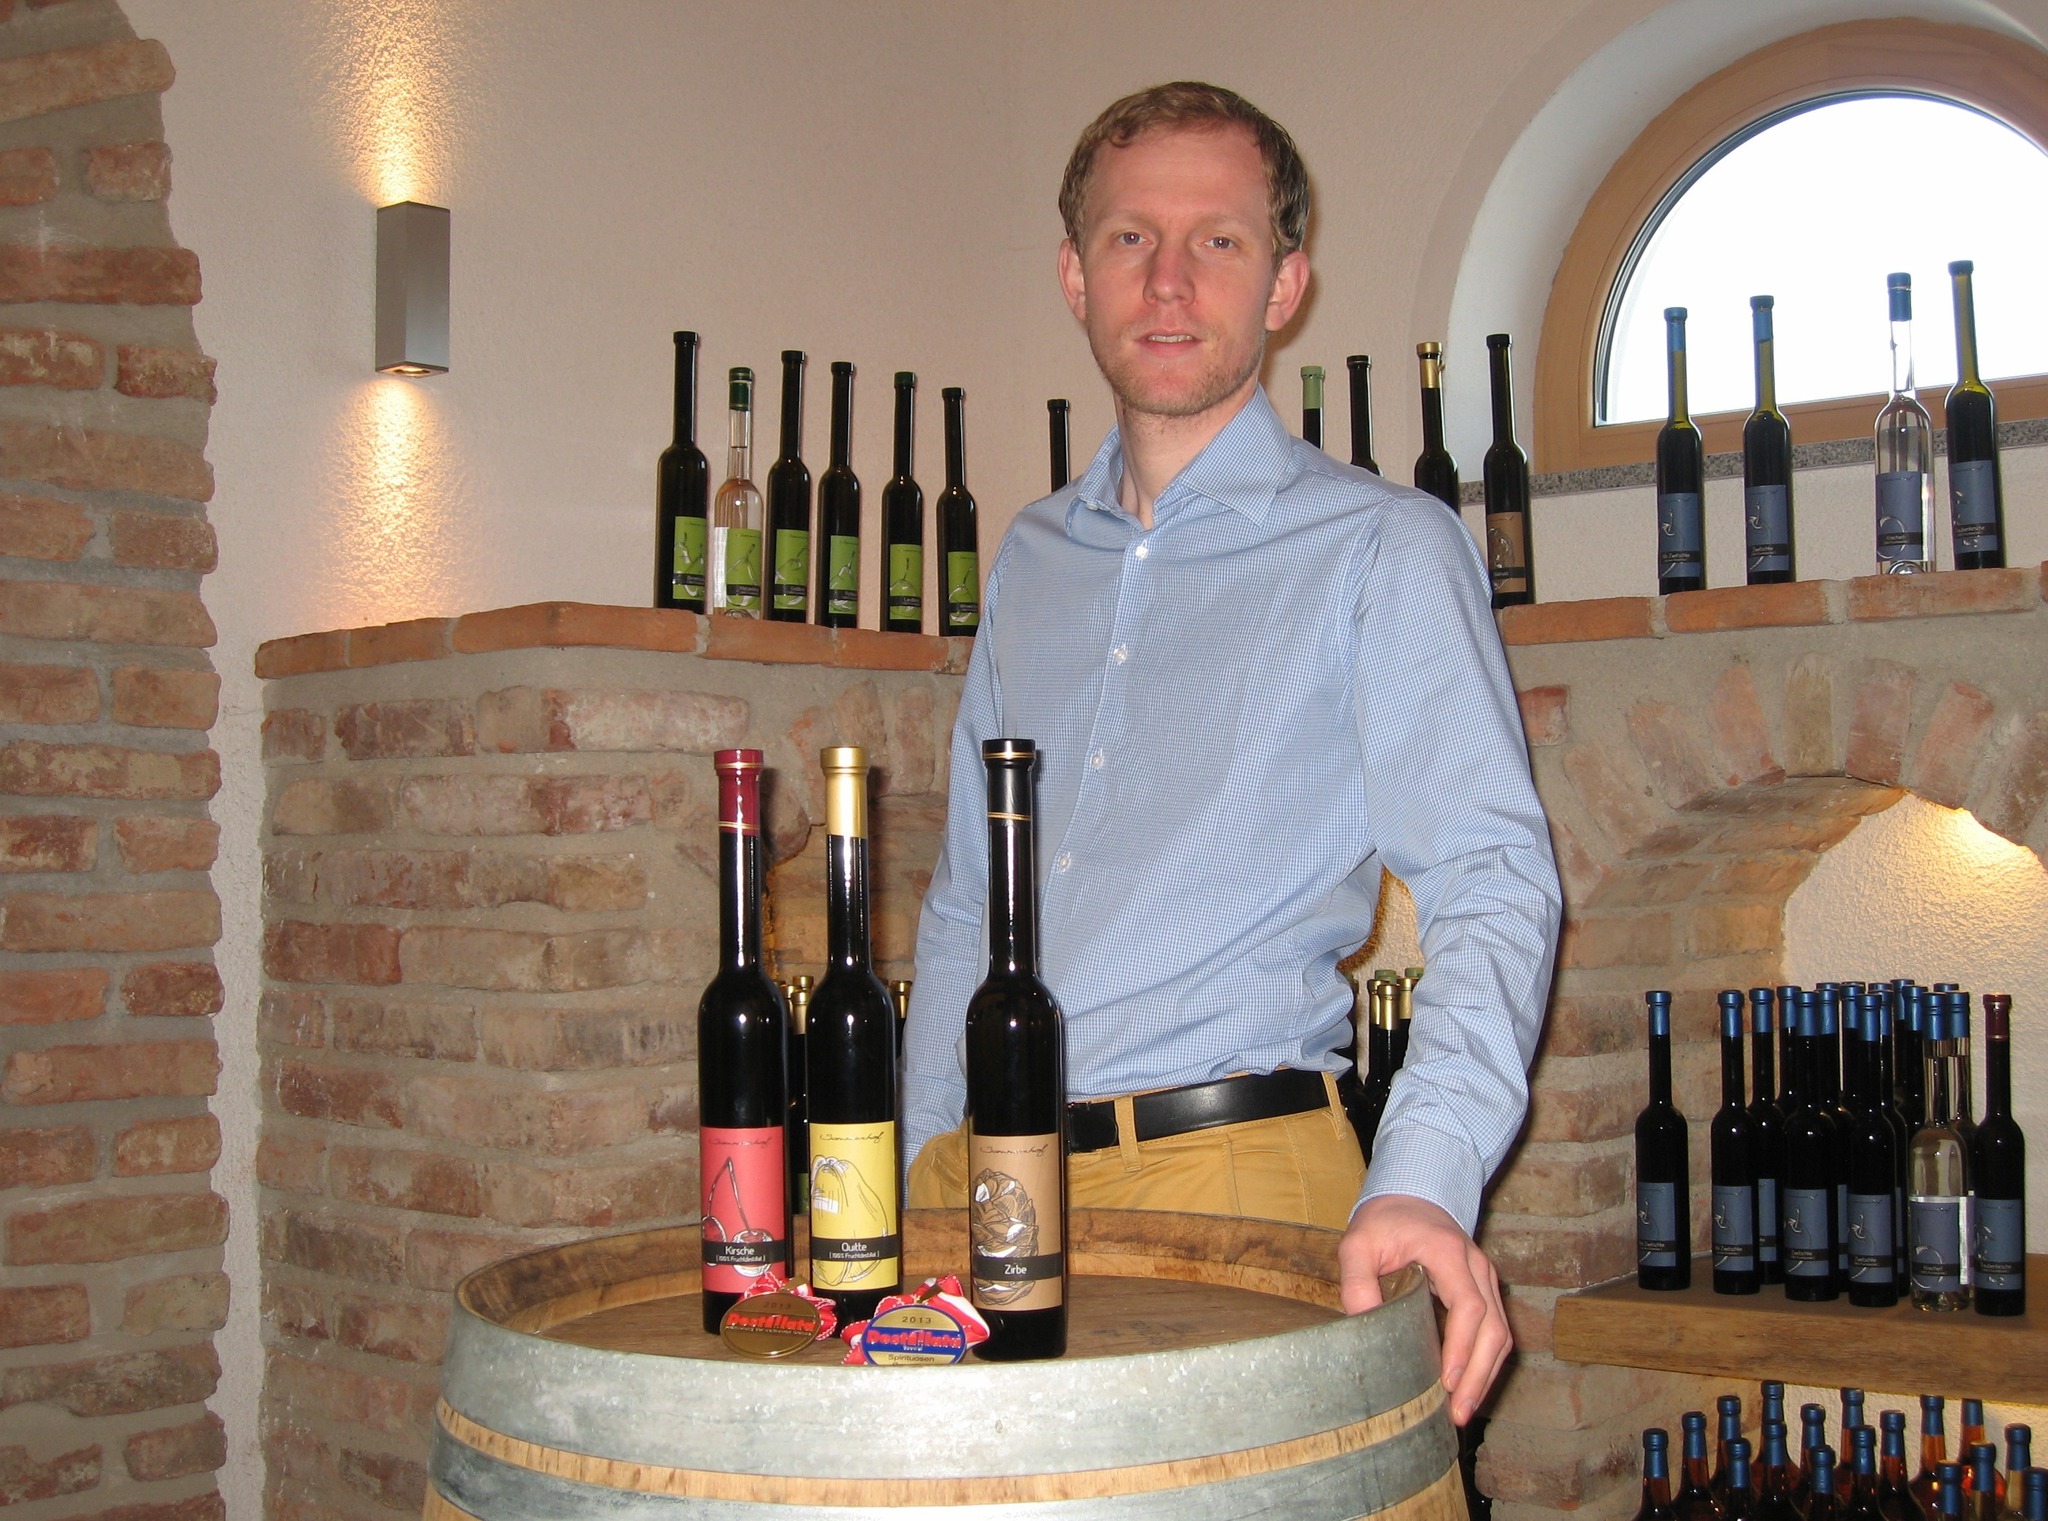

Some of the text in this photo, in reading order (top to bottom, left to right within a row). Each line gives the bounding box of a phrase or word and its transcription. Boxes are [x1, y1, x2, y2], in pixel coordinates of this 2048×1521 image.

[725, 1245, 755, 1256] Kirsche
[841, 1242, 868, 1252] Quitte
[1004, 1264, 1028, 1275] Zirbe
[763, 1302, 792, 1310] 2013
[902, 1316, 932, 1324] 2013
[888, 1354, 935, 1363] Spirituosen
